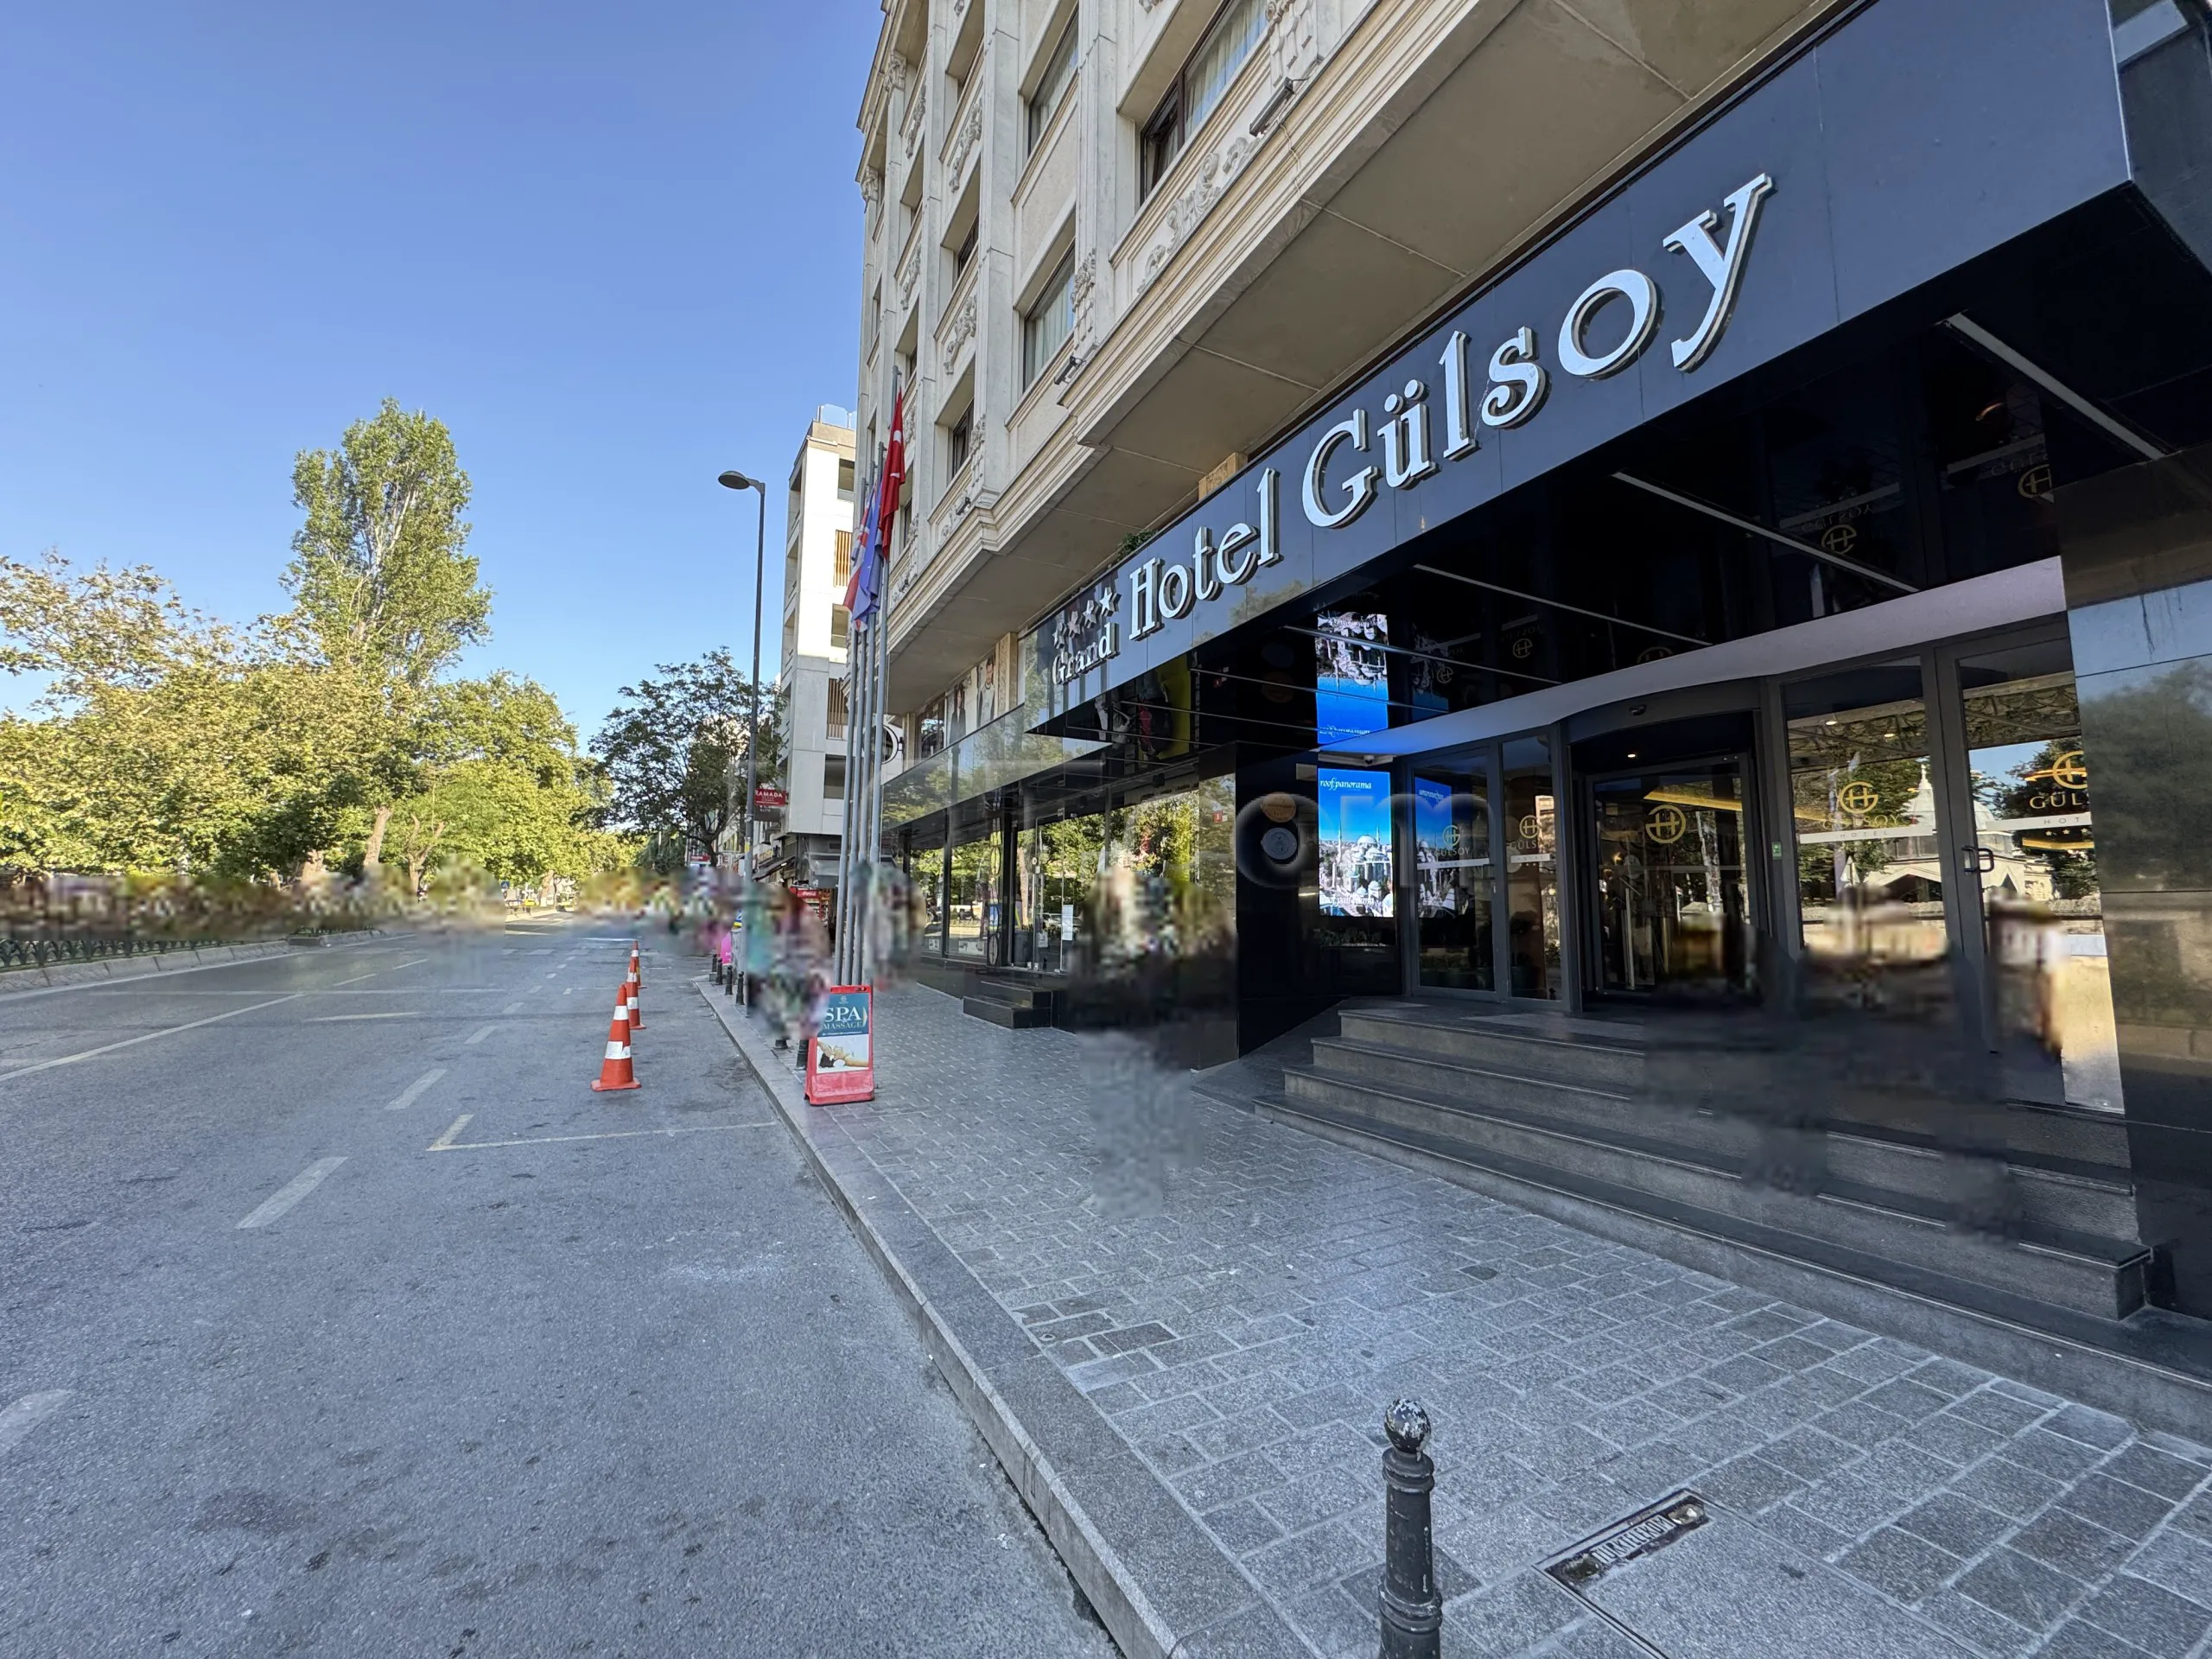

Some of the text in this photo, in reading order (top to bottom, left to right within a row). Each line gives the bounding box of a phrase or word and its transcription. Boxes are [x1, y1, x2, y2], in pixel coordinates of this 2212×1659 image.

[1052, 173, 1773, 685] Grand Hotel Gülsoy
[825, 1007, 862, 1022] SPA
